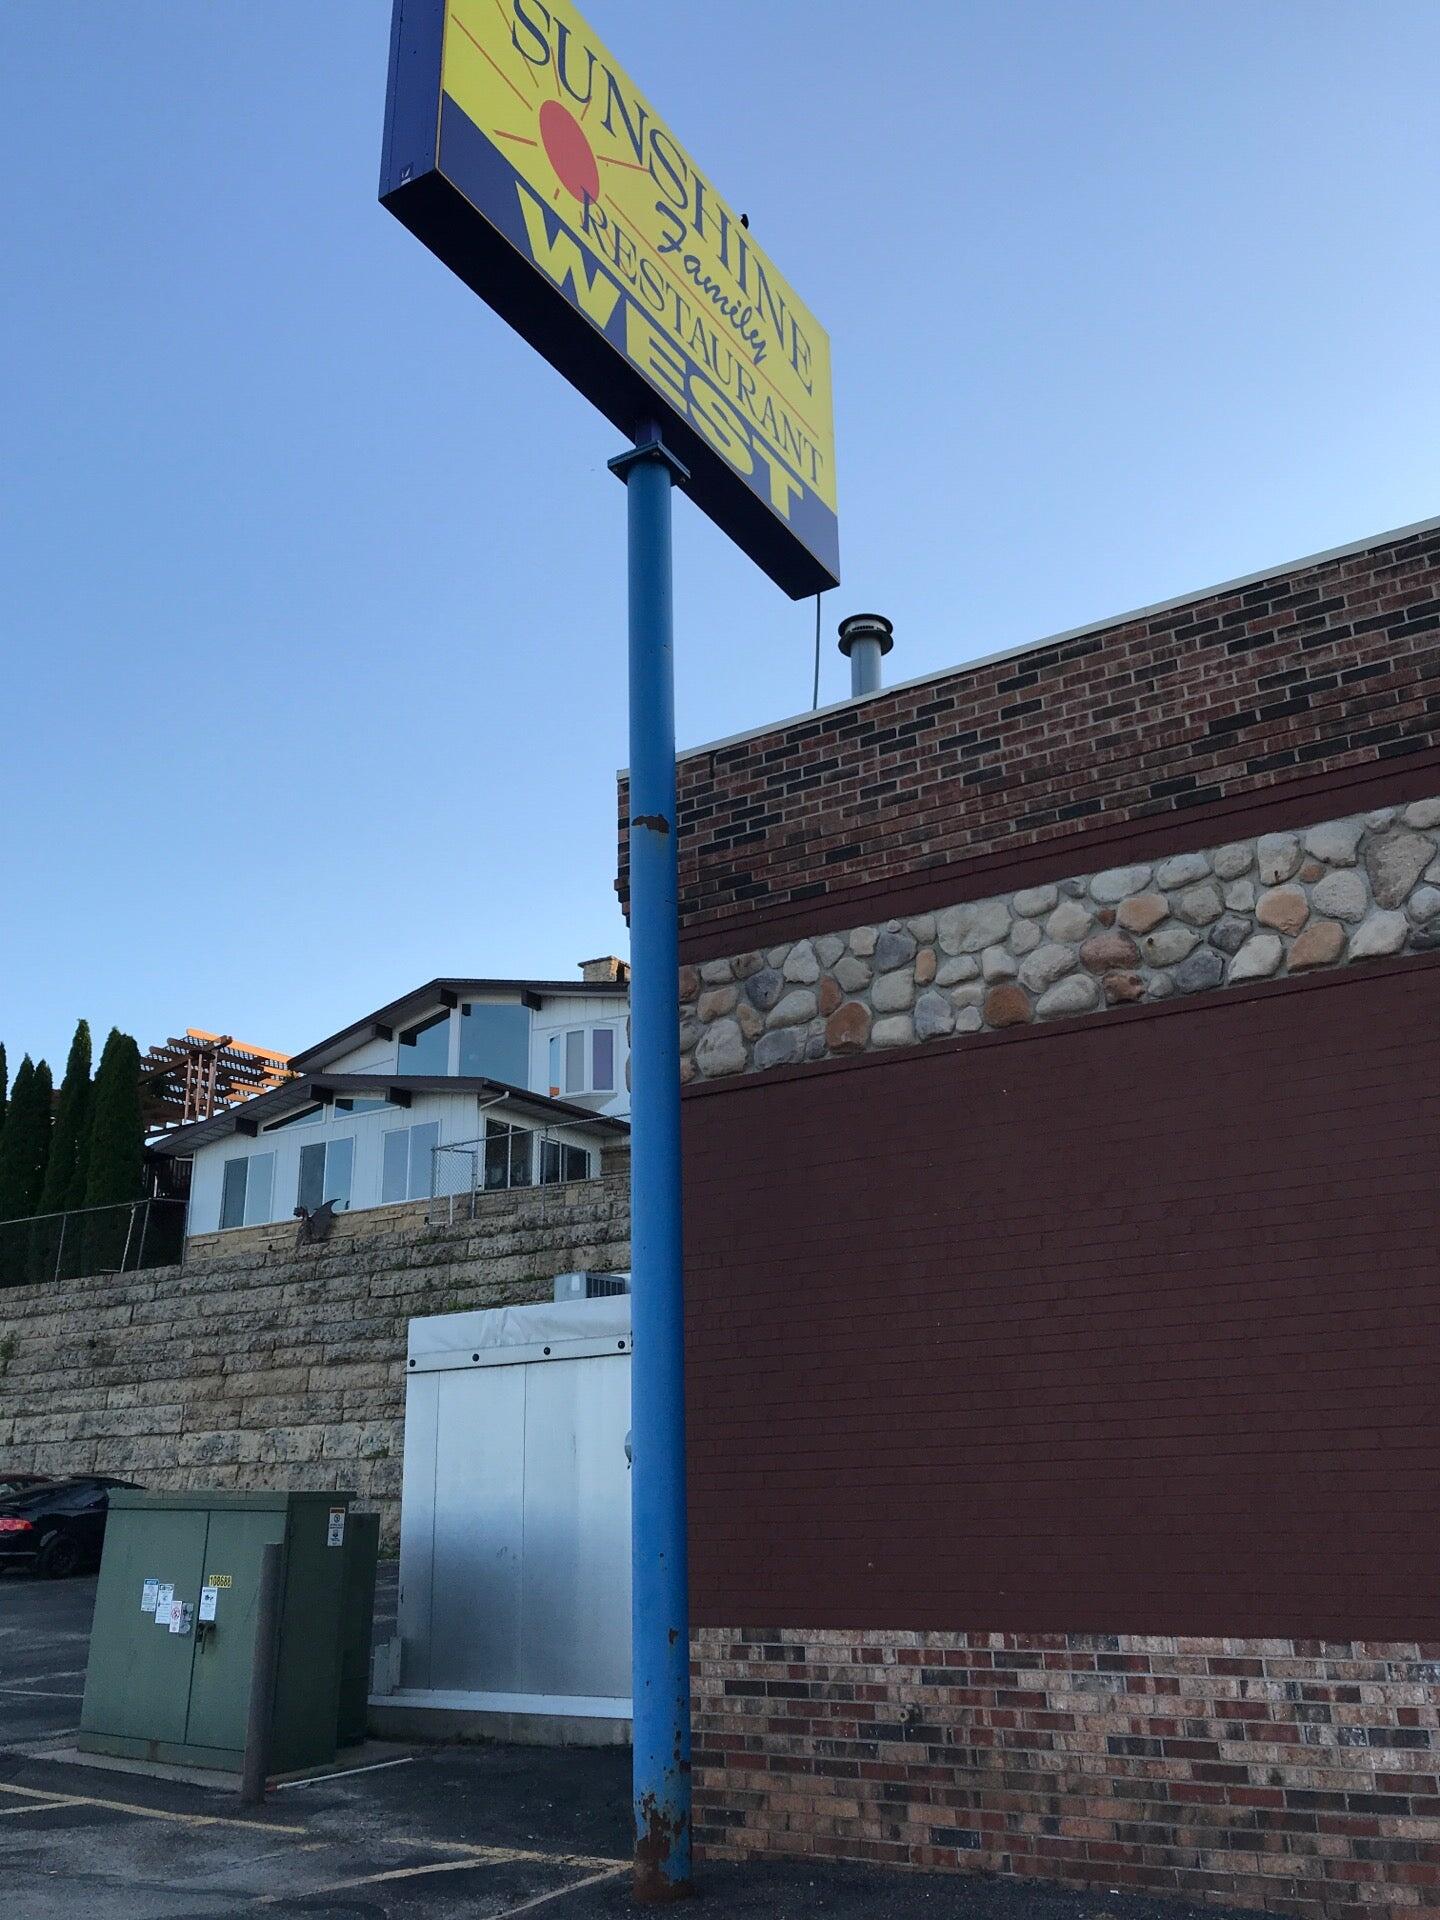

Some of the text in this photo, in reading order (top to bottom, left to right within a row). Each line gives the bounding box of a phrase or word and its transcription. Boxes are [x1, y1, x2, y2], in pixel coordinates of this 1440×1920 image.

[511, 0, 813, 398] SUNSHINE
[515, 180, 804, 521] WEST
[580, 186, 824, 486] RESTAURANT
[655, 200, 767, 366] Family
